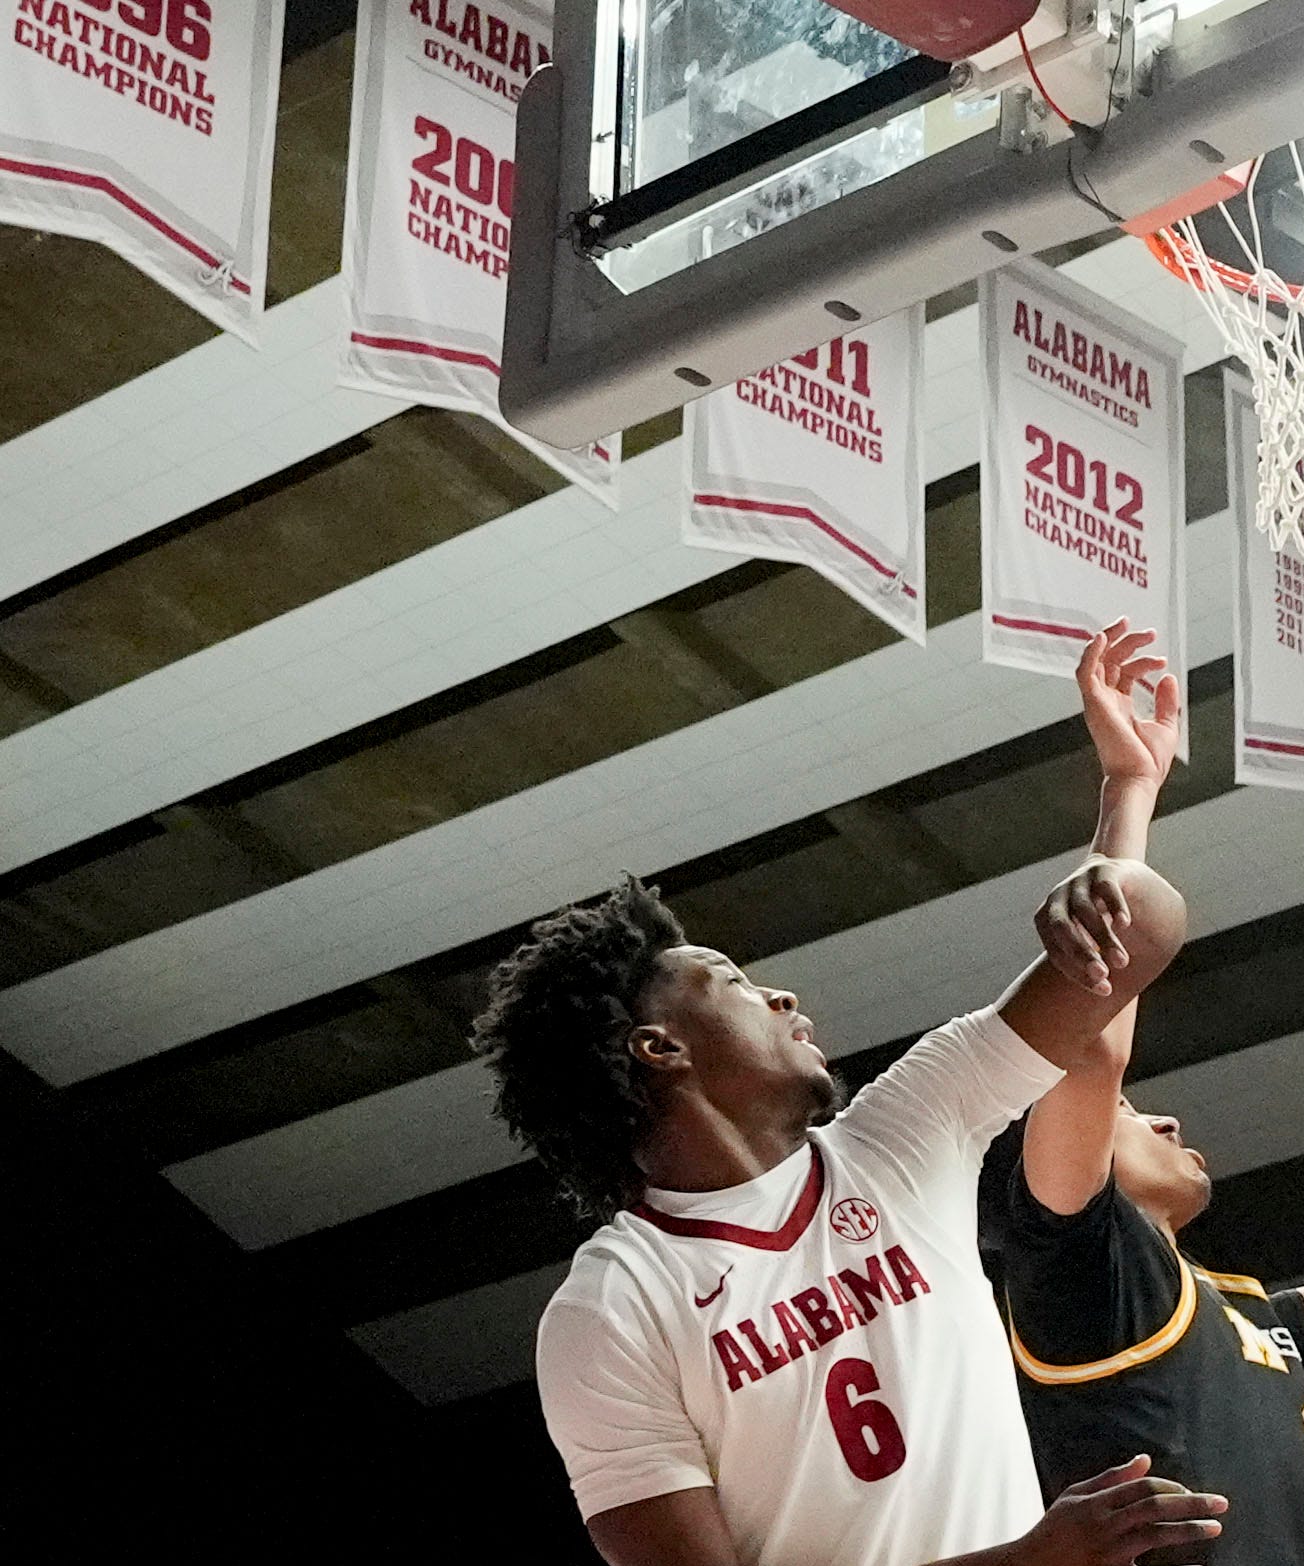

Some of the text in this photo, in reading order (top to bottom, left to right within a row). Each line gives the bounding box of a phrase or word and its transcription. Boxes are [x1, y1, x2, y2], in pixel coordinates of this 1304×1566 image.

[14, 18, 213, 137] CHAMPIONS
[18, 0, 215, 106] NATIONAL
[410, 0, 552, 78] ALABA
[791, 336, 871, 398] 11
[1013, 300, 1152, 410] ALABAMA
[1027, 354, 1139, 428] GYMNASTICS
[736, 379, 883, 464] CHAMPIONS
[757, 363, 882, 437] ATIONAL
[1025, 424, 1143, 531] 2012
[1024, 479, 1148, 563] NATIONAL
[1025, 506, 1148, 590] CHAMPIONS
[712, 1244, 931, 1392] ALABAMA
[825, 1357, 906, 1482] 6
